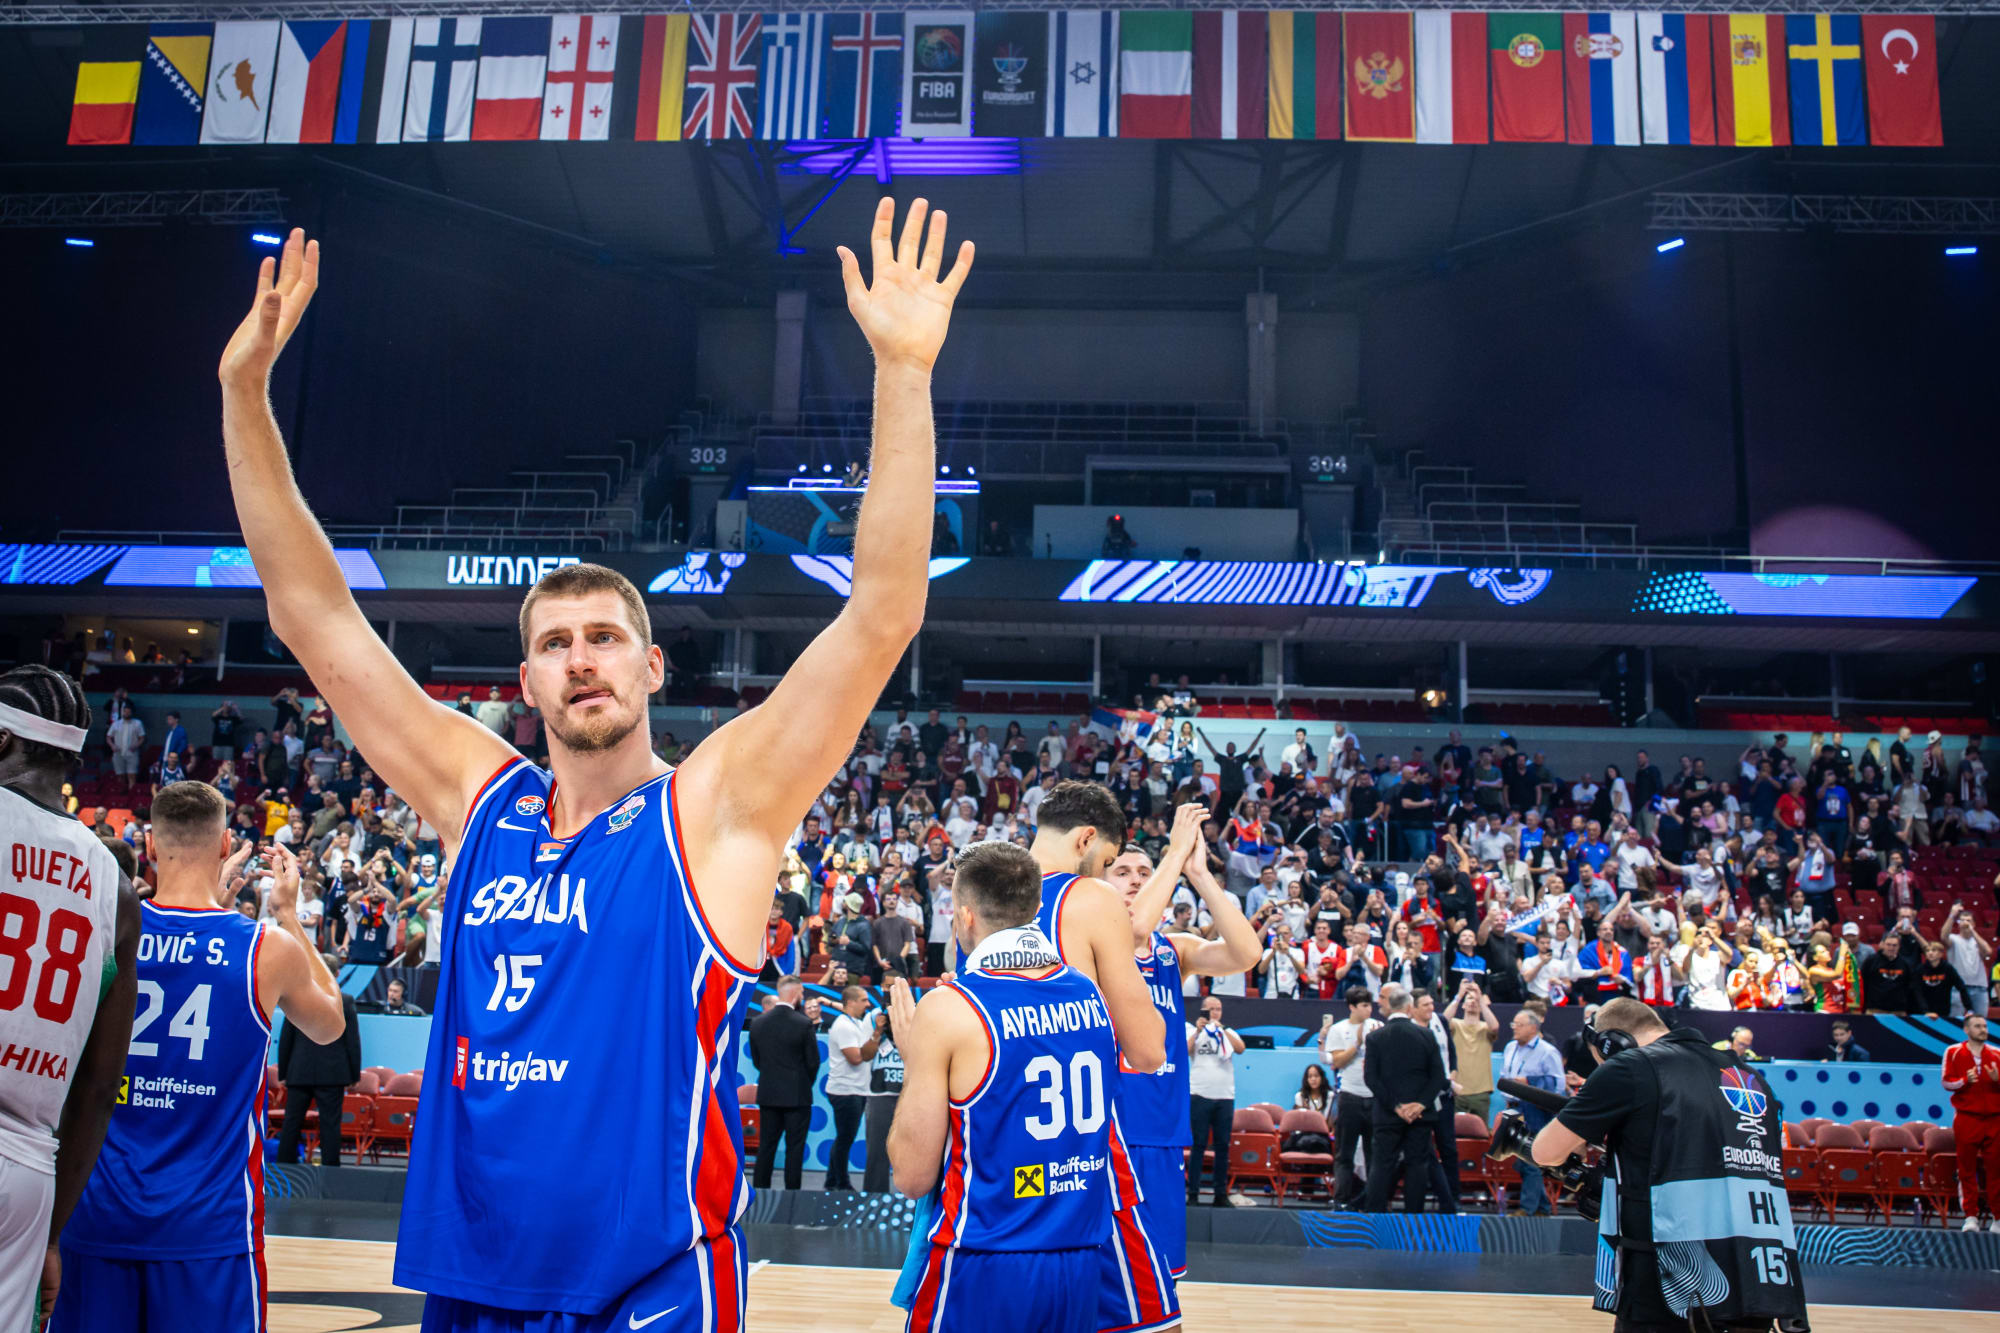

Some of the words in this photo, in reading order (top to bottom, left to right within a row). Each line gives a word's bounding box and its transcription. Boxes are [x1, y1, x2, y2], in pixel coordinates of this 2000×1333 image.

[920, 82, 955, 98] FIBA
[690, 448, 727, 464] 303
[1309, 456, 1347, 473] 304
[11, 843, 93, 900] QUETA
[0, 892, 94, 1025] 88
[206, 938, 229, 966] S.
[1022, 939, 1040, 950] FIBA
[486, 954, 543, 1012] 15
[128, 979, 213, 1061] 24
[1000, 993, 1108, 1040] AVRAMOVIĆ
[0, 1043, 68, 1082] HIKA
[472, 1051, 569, 1091] triglav
[132, 1092, 175, 1110] Bank
[134, 1075, 216, 1096] Raiffeisen
[1024, 1050, 1106, 1141] 30
[1049, 1175, 1088, 1195] Bank
[1750, 1246, 1794, 1287] 15
